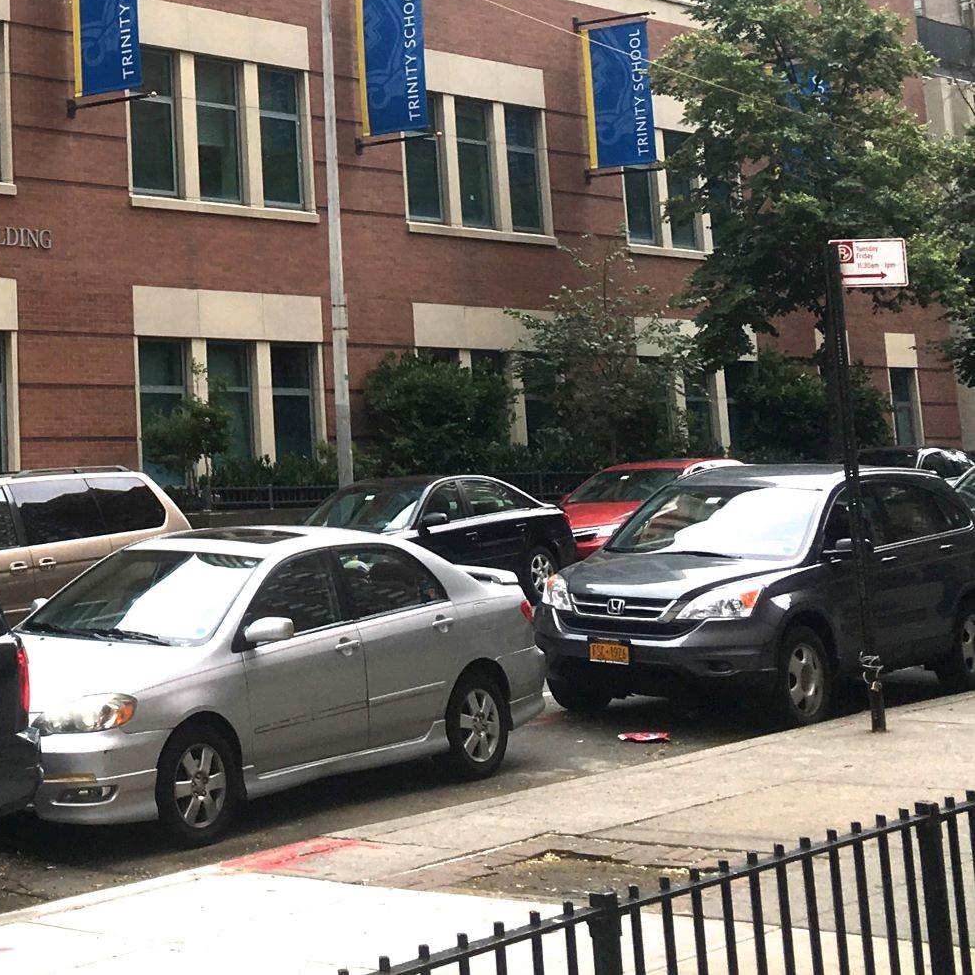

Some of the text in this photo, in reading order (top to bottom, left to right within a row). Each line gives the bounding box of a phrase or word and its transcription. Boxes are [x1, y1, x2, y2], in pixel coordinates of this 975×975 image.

[119, 4, 135, 80] TRINITY
[404, 55, 421, 122] TRINITY
[629, 29, 650, 157] TRINITY SCHOOL
